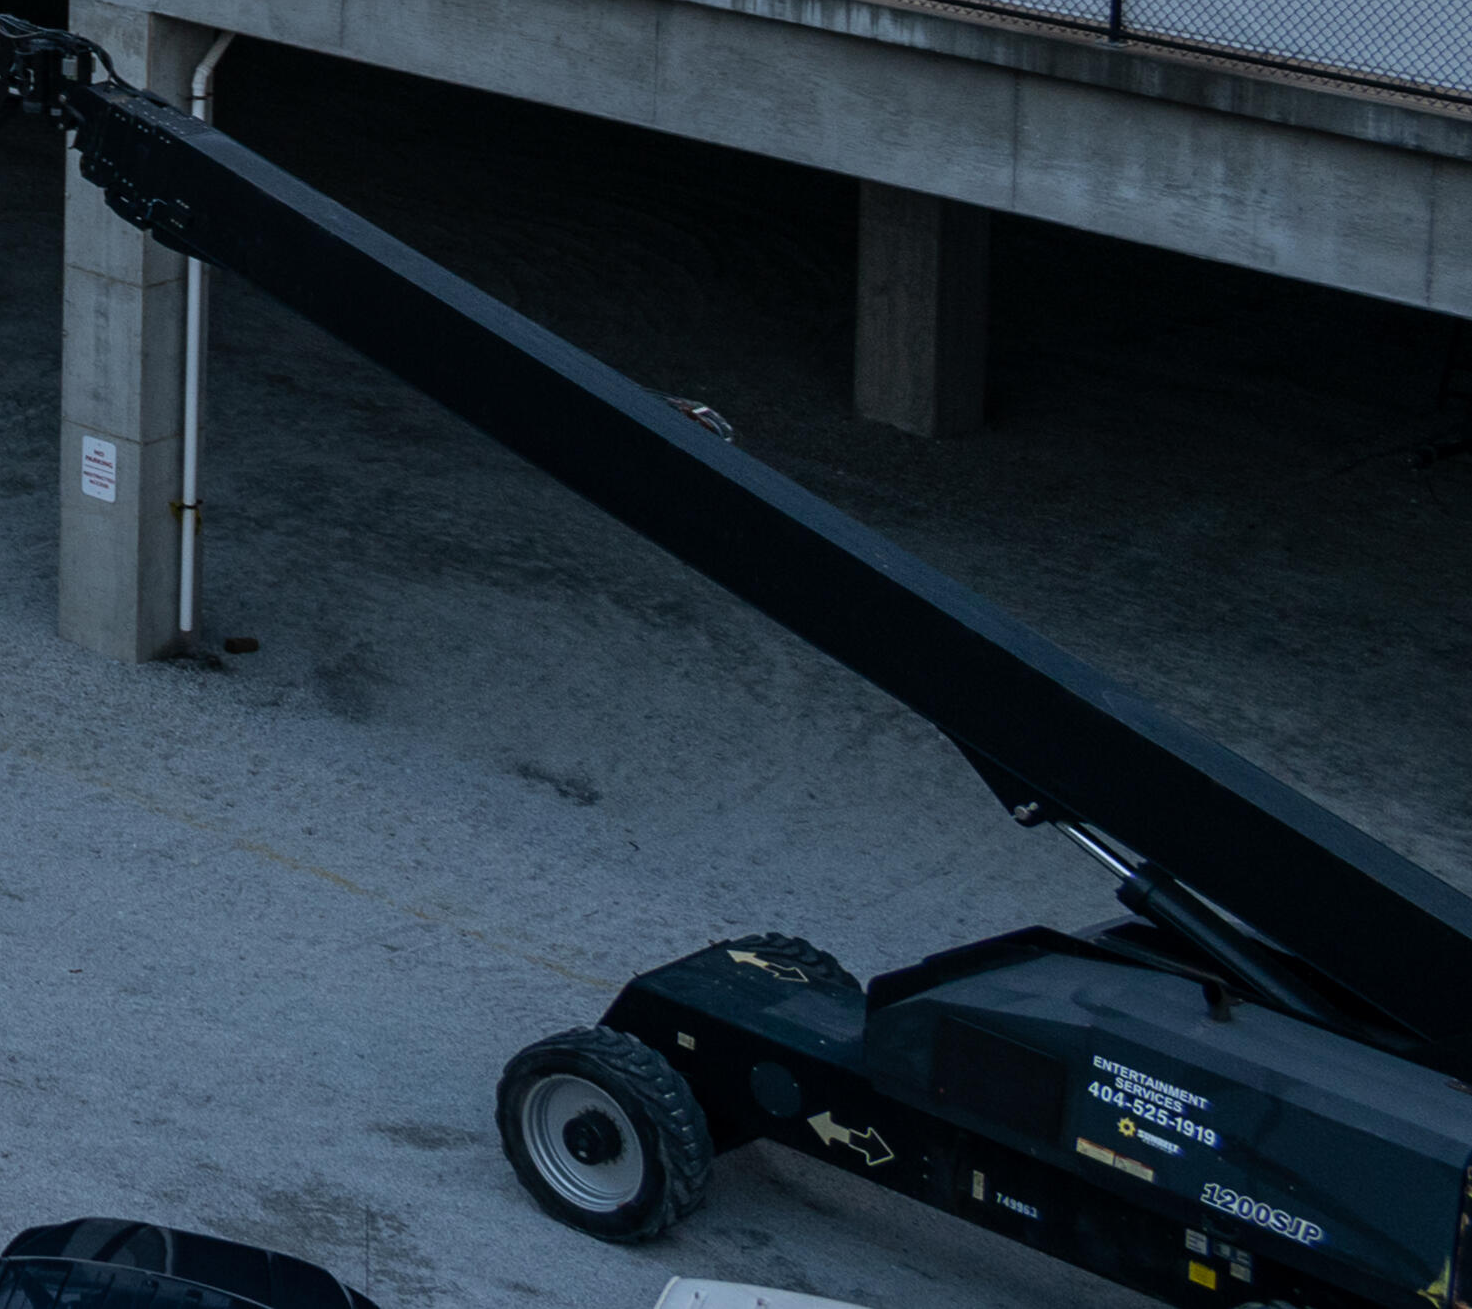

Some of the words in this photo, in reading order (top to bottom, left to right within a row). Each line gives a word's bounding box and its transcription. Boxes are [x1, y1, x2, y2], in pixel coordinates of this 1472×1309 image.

[86, 454, 113, 469] PARKING
[94, 449, 105, 457] NO
[1093, 1055, 1210, 1110] ENTERTAINMENT
[1115, 1076, 1183, 1113] SERVICES
[1088, 1081, 1216, 1147] 404-525-1919
[1200, 1182, 1324, 1245] 1200SJP
